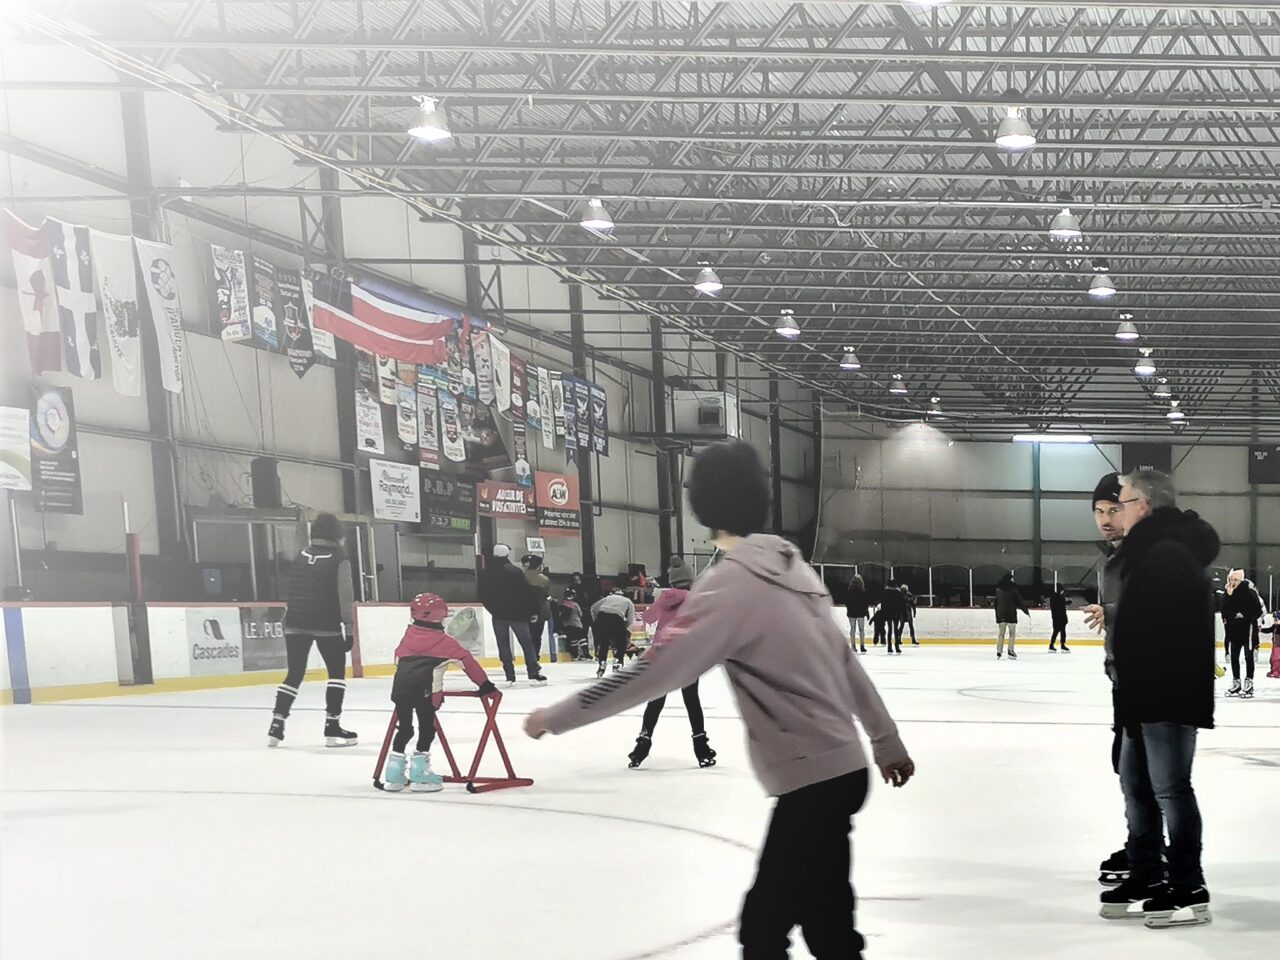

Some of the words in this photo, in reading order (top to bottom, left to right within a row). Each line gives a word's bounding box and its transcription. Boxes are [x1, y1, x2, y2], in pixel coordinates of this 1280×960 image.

[244, 622, 258, 639] LE
[264, 621, 284, 639] PUB
[193, 642, 240, 660] Cascades
